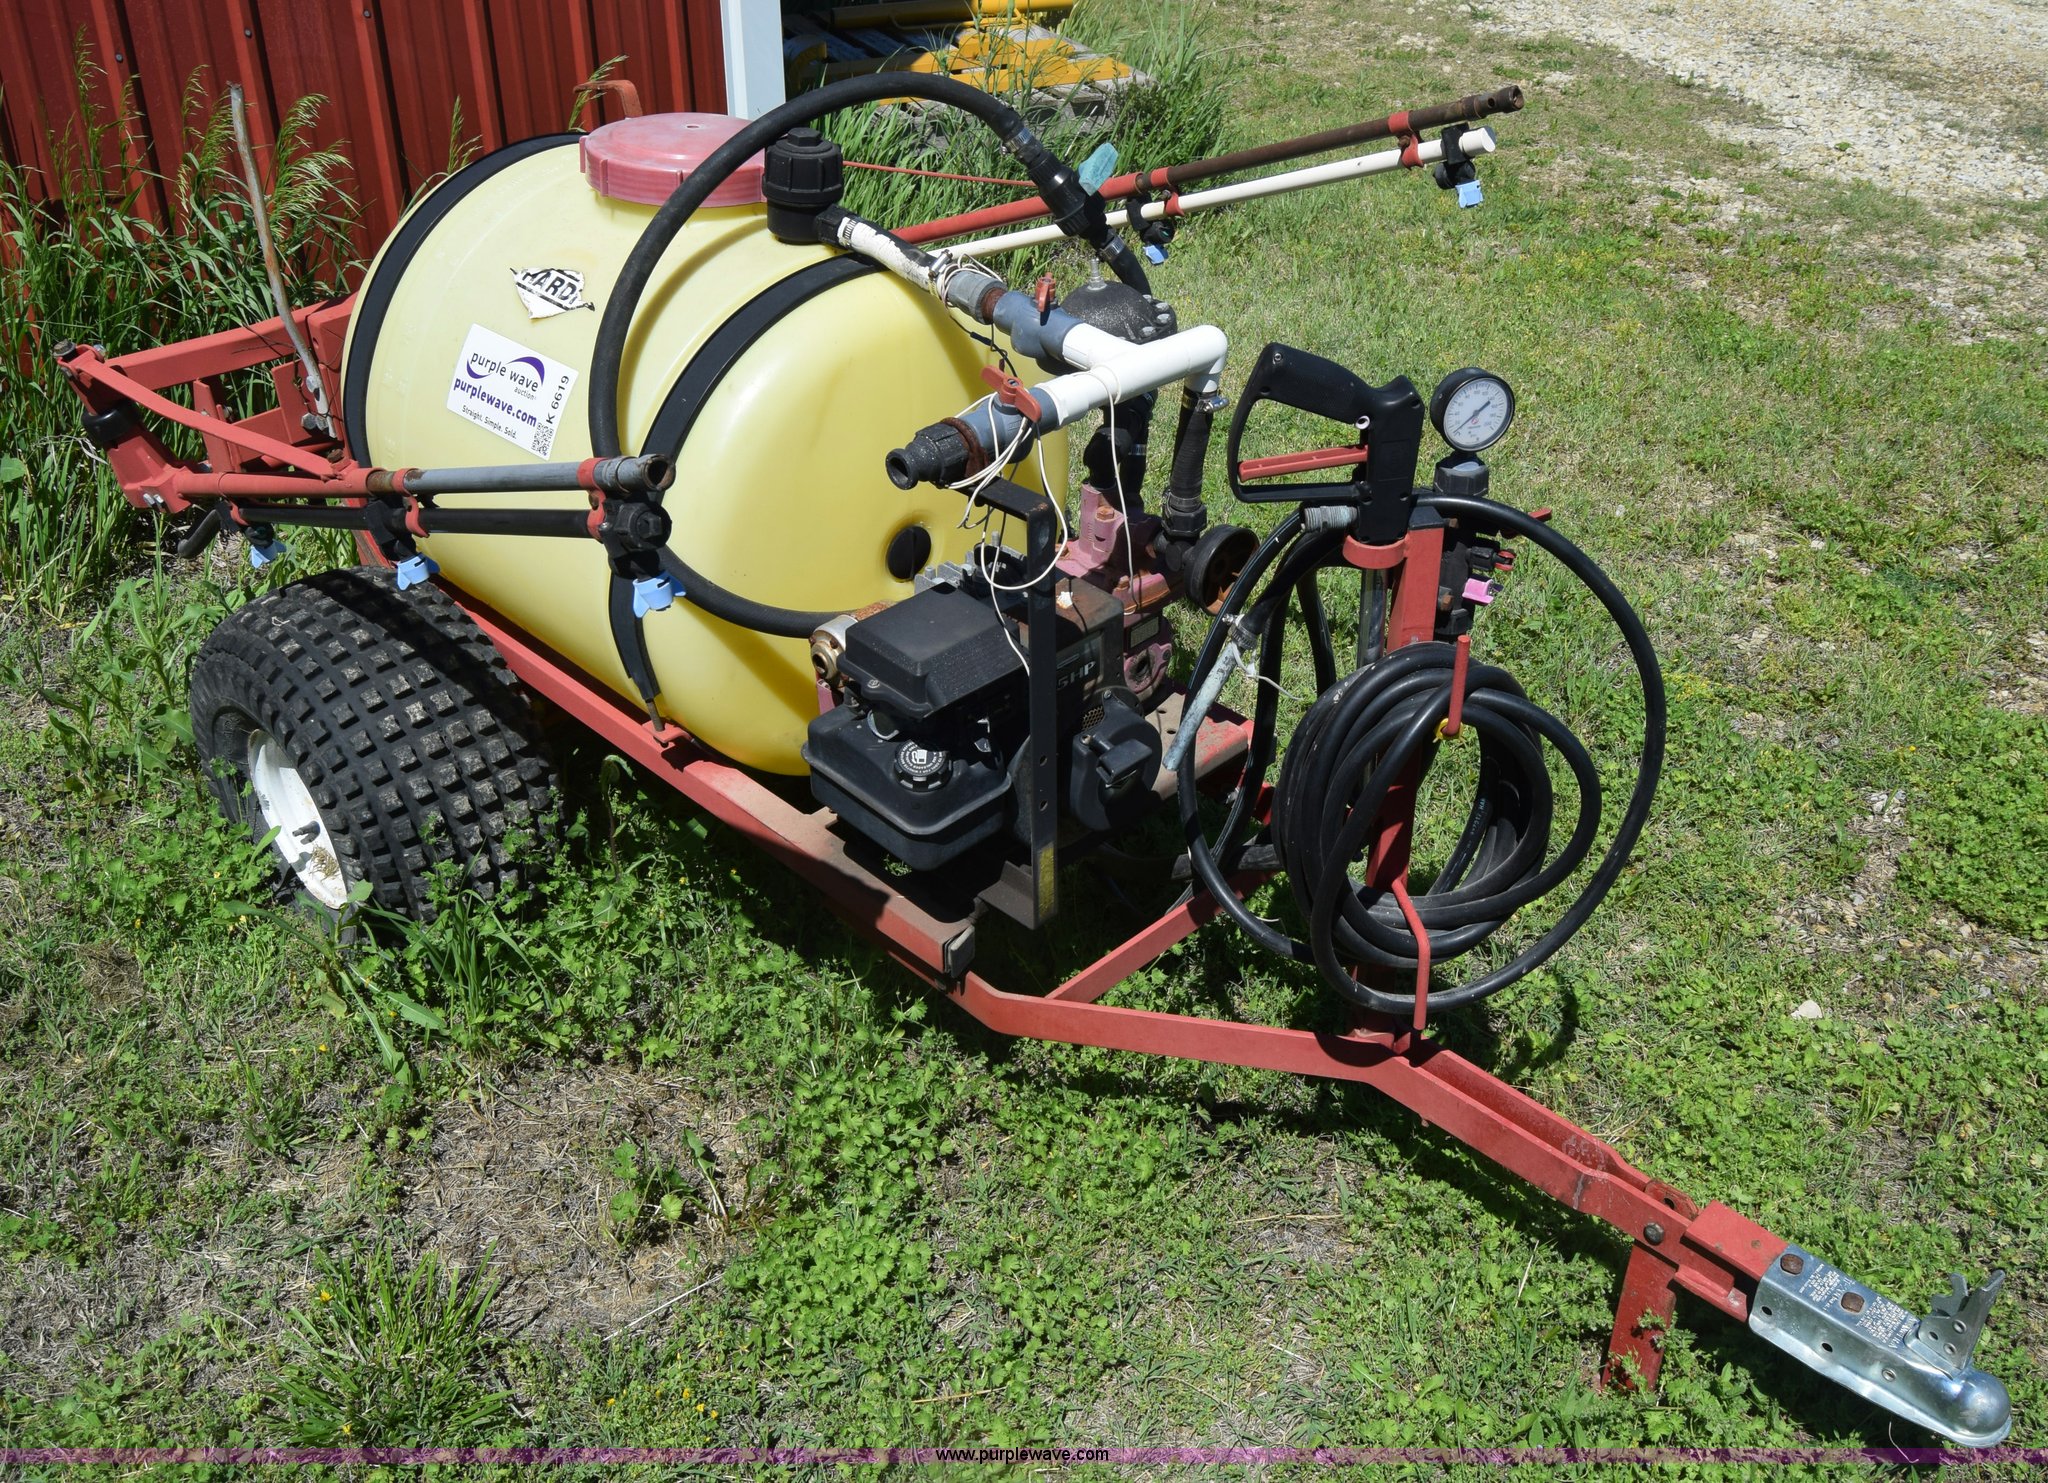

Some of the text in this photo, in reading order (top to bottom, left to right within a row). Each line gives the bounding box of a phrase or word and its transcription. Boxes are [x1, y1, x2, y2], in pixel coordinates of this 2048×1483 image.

[470, 352, 539, 392] purple wave
[453, 378, 538, 428] purplewave.com
[462, 404, 518, 440] Straight. Simple. Sold.
[545, 376, 570, 425] K 6619
